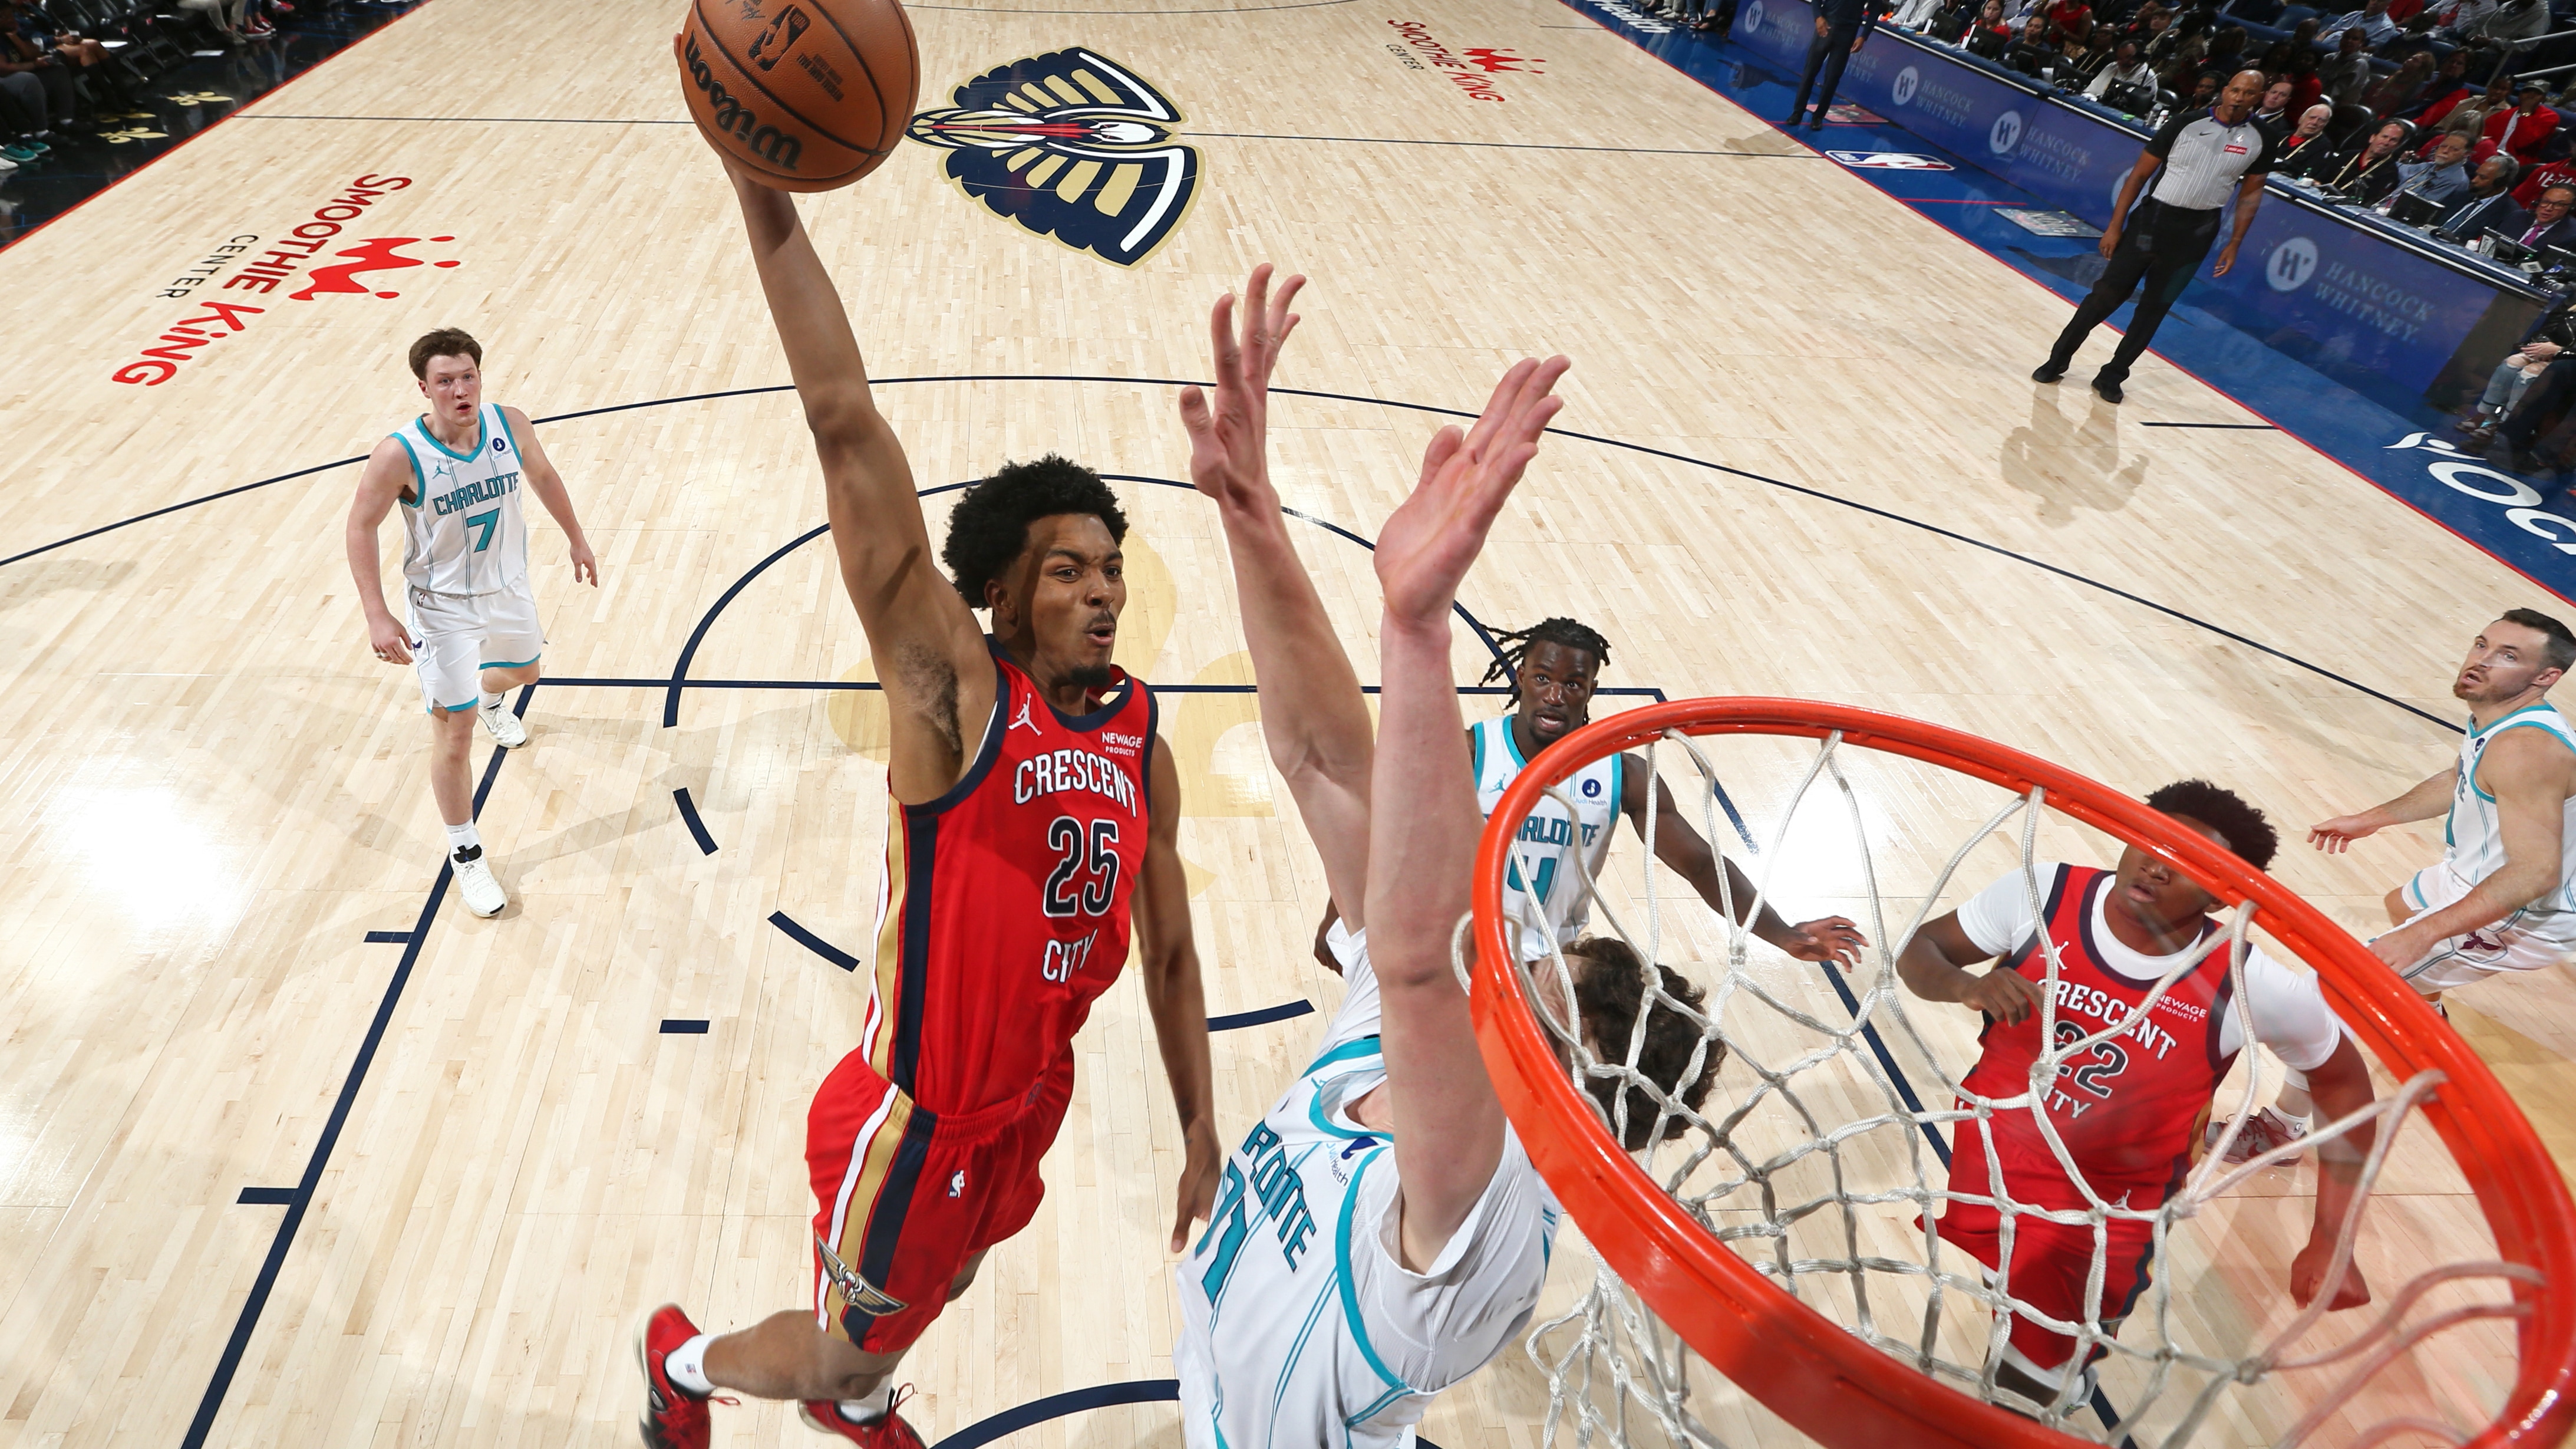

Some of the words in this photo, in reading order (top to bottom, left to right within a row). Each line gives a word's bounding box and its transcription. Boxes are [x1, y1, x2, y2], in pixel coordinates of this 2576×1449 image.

[793, 12, 806, 28] NBA
[1386, 44, 1424, 70] CENTER
[1387, 19, 1467, 70] SMOOTHIE
[685, 29, 802, 171] Wilson
[1921, 80, 1974, 113] HANCOCK
[2025, 127, 2091, 166] HANCOCK
[222, 174, 412, 293] SMOOTHIE
[155, 235, 259, 298] CENTER
[2325, 262, 2435, 322] HANCOCK
[432, 471, 519, 516] CHARLOTTE
[466, 507, 500, 552] 7
[1101, 731, 1143, 749] NEWAGE
[1105, 745, 1135, 757] PRODUCTS
[1014, 748, 1137, 818] CRESCENT
[1043, 815, 1120, 918] 25
[1043, 927, 1098, 983] CITY
[2156, 1002, 2198, 1023] PRODUCTS
[2039, 1019, 2129, 1099] 22
[2041, 1085, 2092, 1119] ITY
[1330, 1156, 1349, 1187] Health
